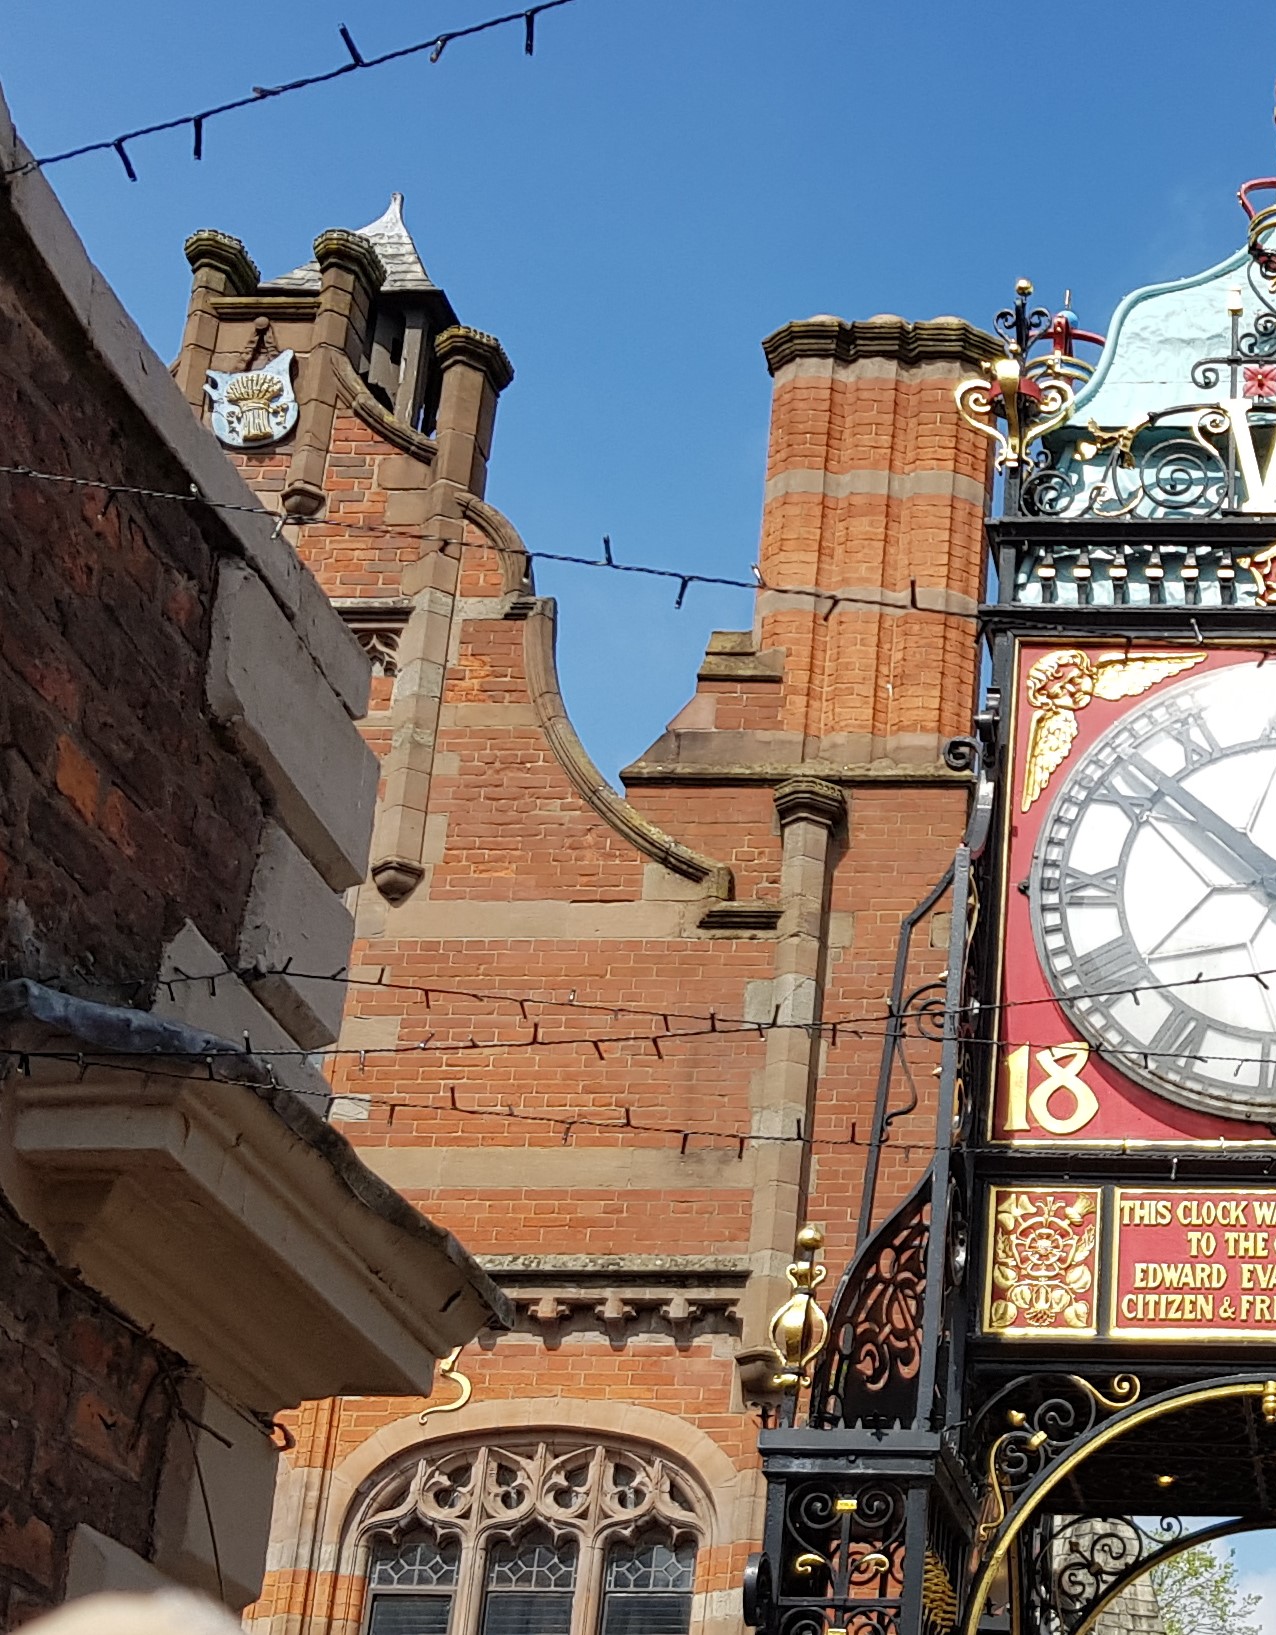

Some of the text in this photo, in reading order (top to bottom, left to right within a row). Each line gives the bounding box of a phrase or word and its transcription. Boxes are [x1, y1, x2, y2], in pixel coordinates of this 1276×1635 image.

[1003, 1040, 1100, 1135] 18
[1120, 1200, 1173, 1226] THIS
[1176, 1200, 1248, 1227] CLOCK
[1187, 1231, 1217, 1258] TO
[1224, 1231, 1270, 1258] THE
[1133, 1262, 1228, 1290] EDWARD
[1121, 1293, 1214, 1321] CITIZEN
[1218, 1296, 1237, 1321] &
